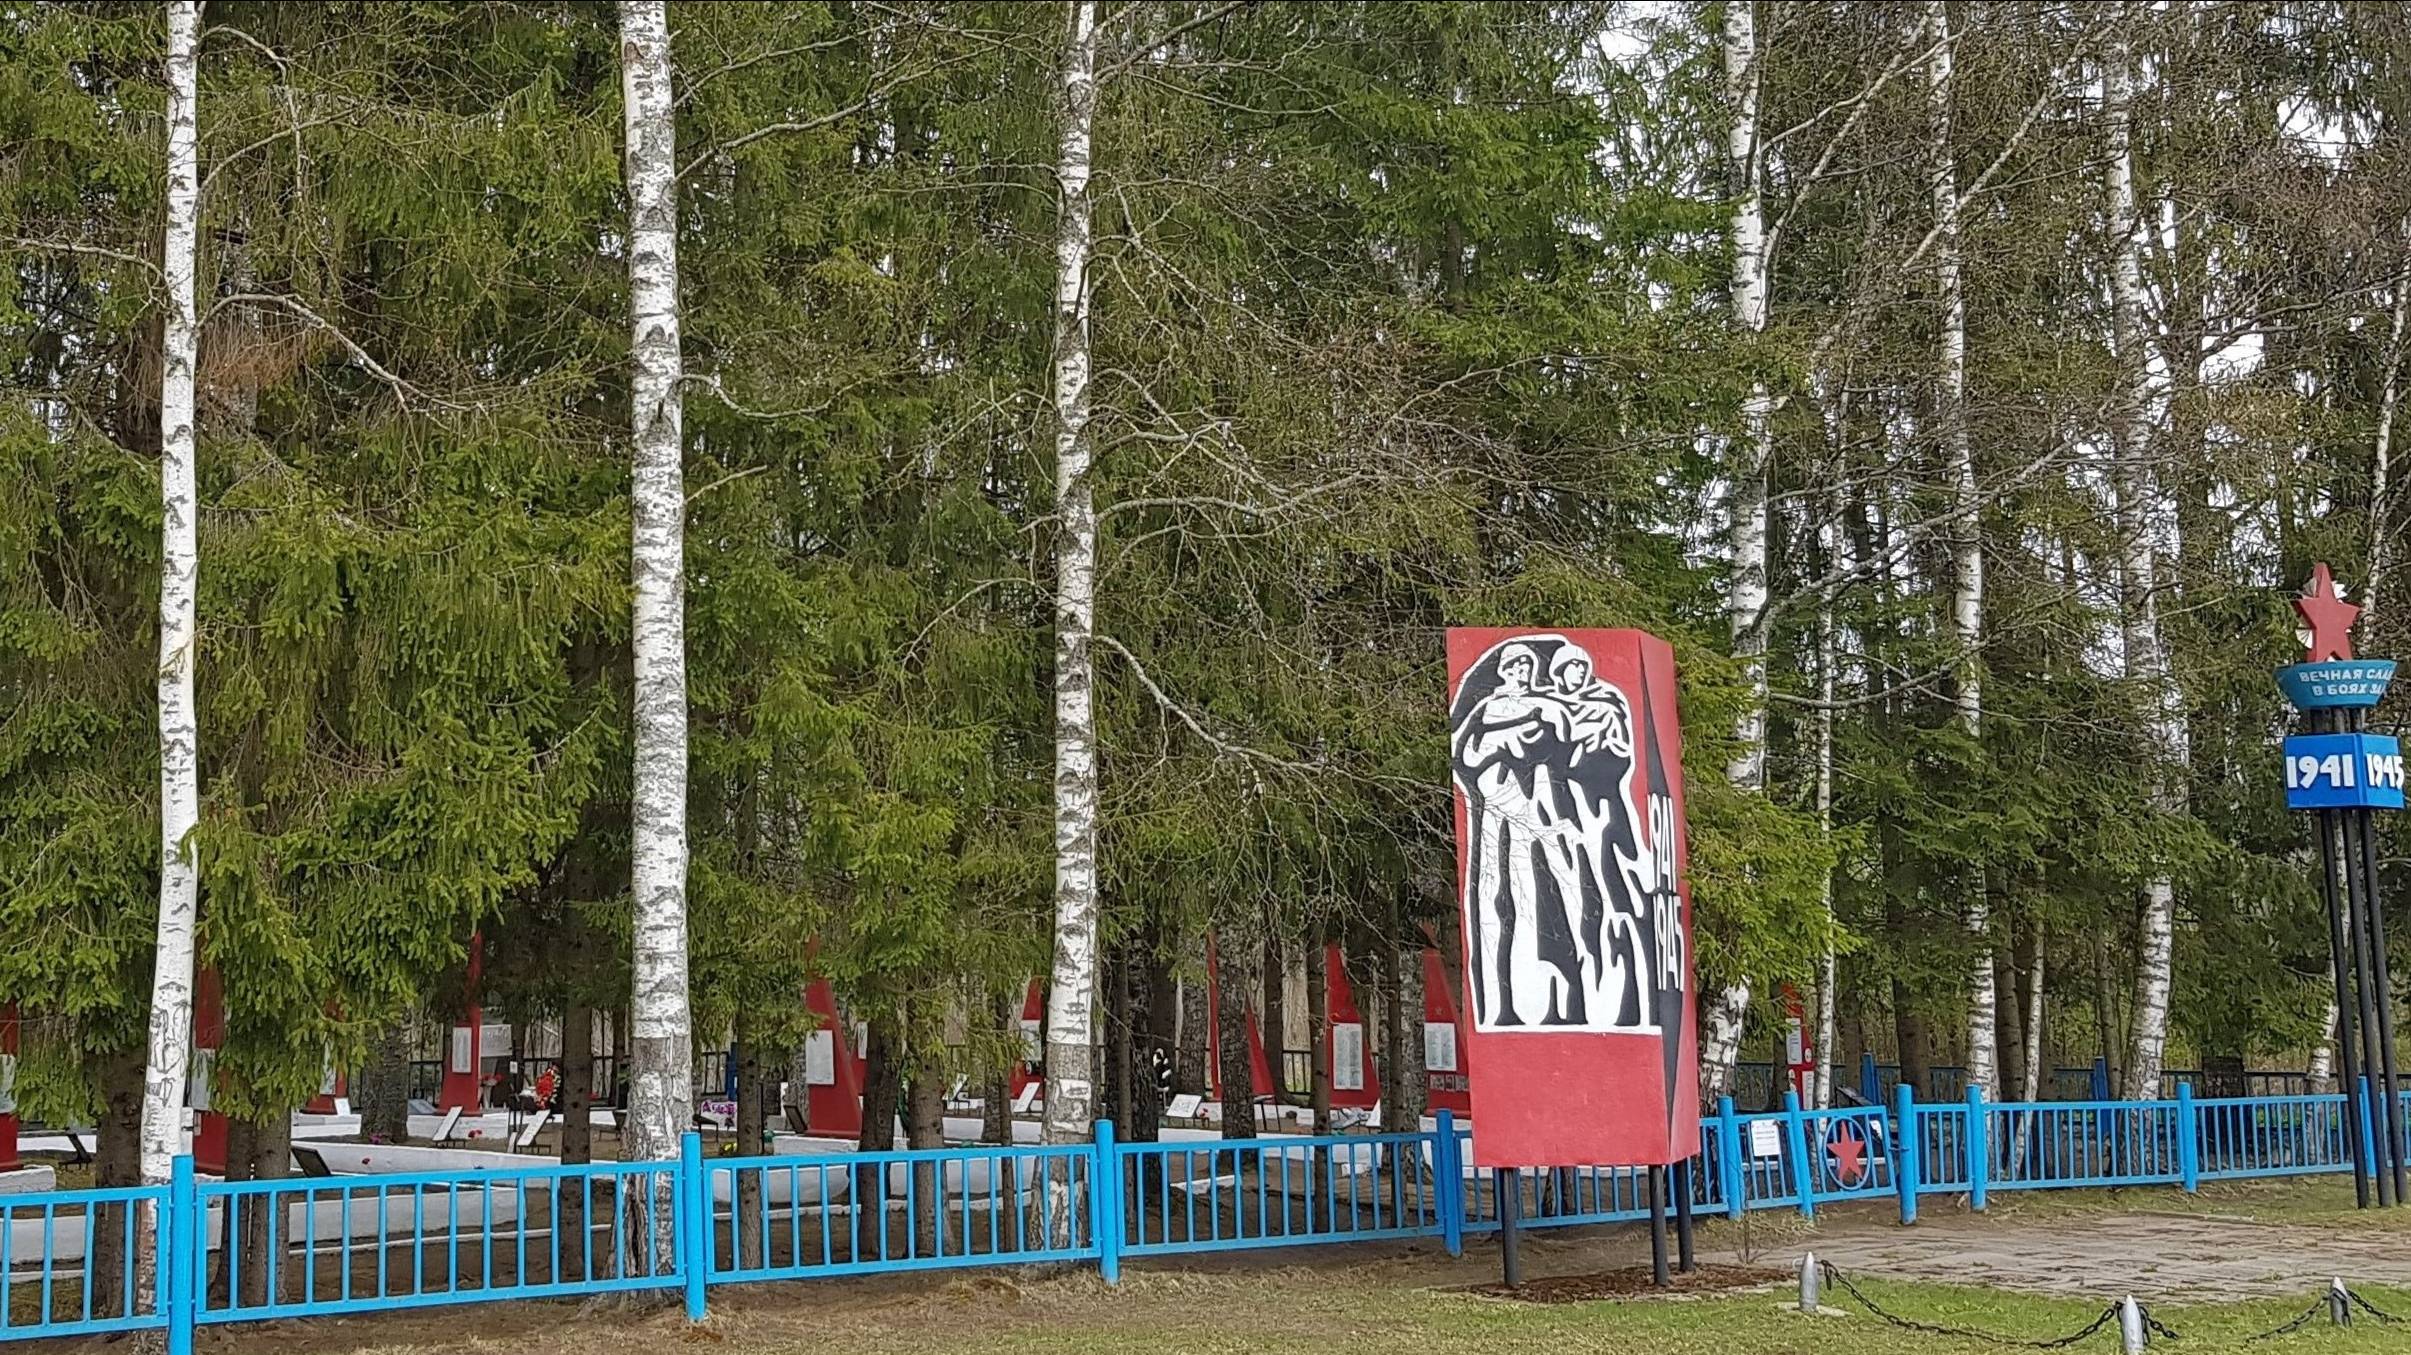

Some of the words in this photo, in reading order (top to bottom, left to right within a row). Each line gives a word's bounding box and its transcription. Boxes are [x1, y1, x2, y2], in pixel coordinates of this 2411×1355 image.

[2299, 669, 2363, 682] ВЕЧНАЯ
[2312, 685, 2323, 696] В
[2327, 683, 2367, 695] БОЯХ
[2286, 754, 2355, 788] 1941
[2366, 753, 2405, 789] 1945
[1647, 793, 1677, 896] 1941
[1653, 893, 1685, 992] 1945
